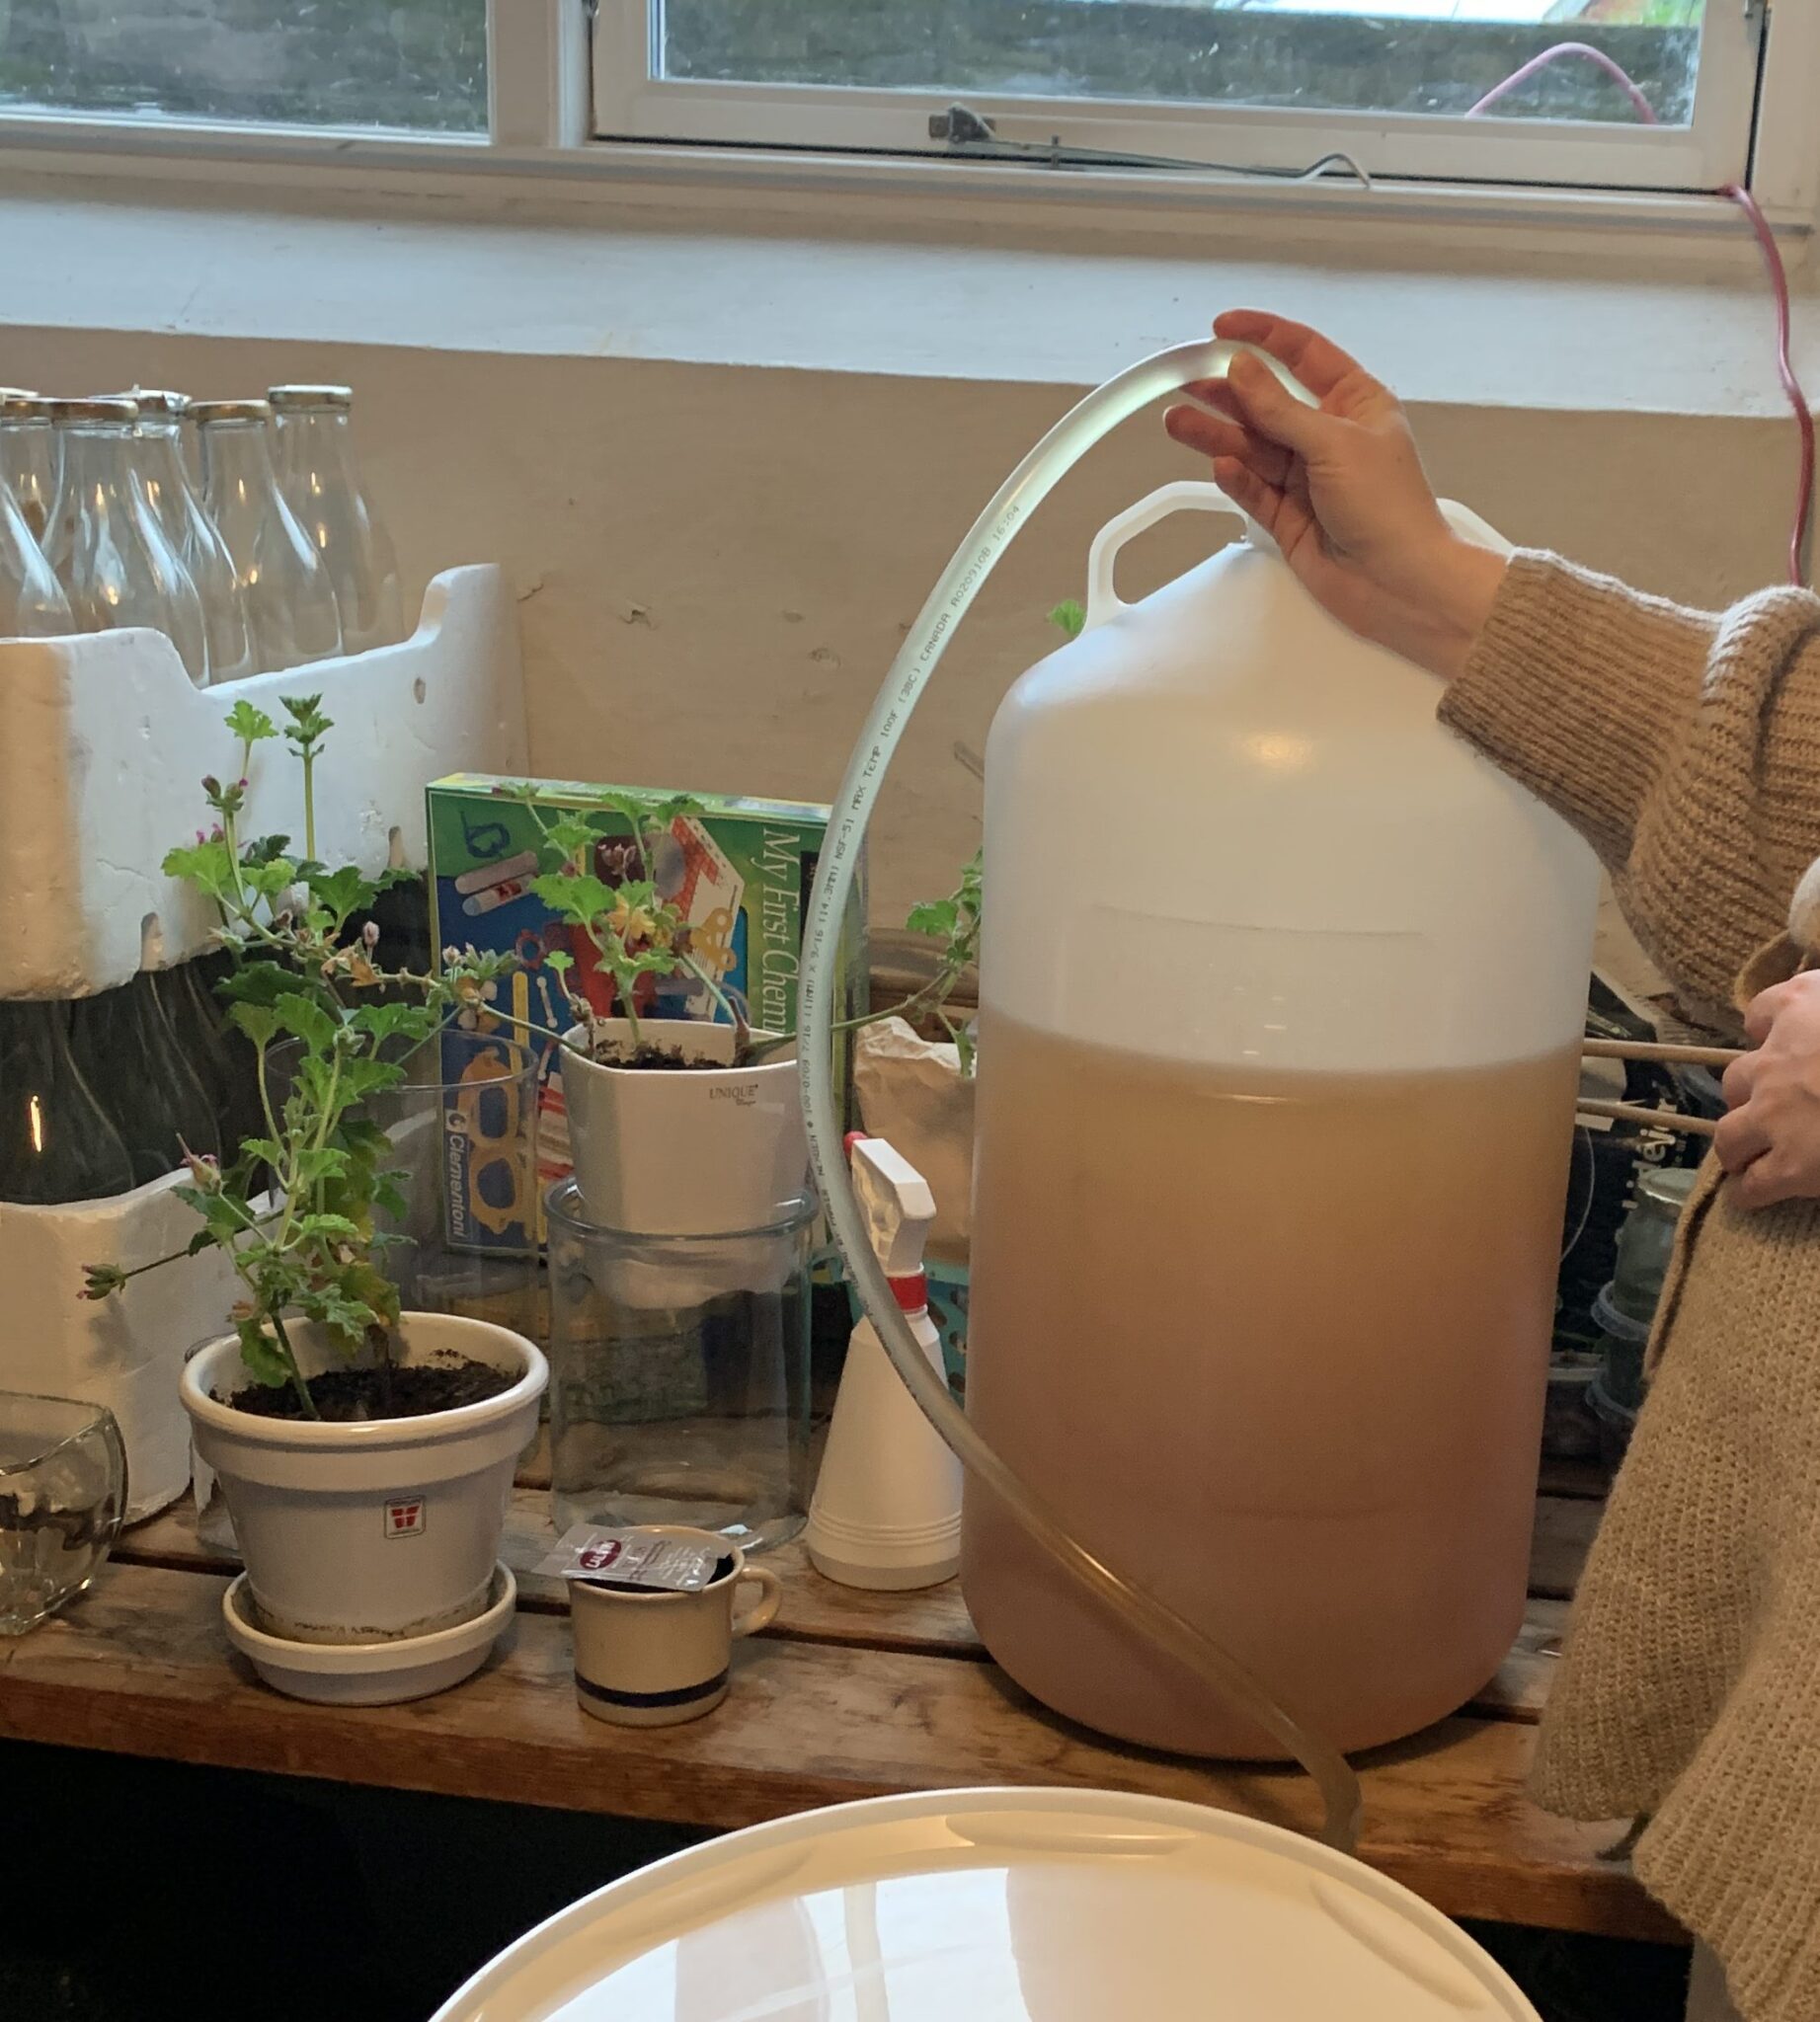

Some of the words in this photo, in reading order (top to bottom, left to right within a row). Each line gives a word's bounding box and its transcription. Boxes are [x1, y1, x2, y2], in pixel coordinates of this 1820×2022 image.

[833, 818, 854, 860] NSF-51
[851, 785, 866, 811] MAX
[862, 745, 881, 778] TEMP
[920, 613, 951, 661] CANADA
[751, 828, 800, 880] My
[762, 884, 800, 944] First
[449, 1134, 467, 1238] Clementoni
